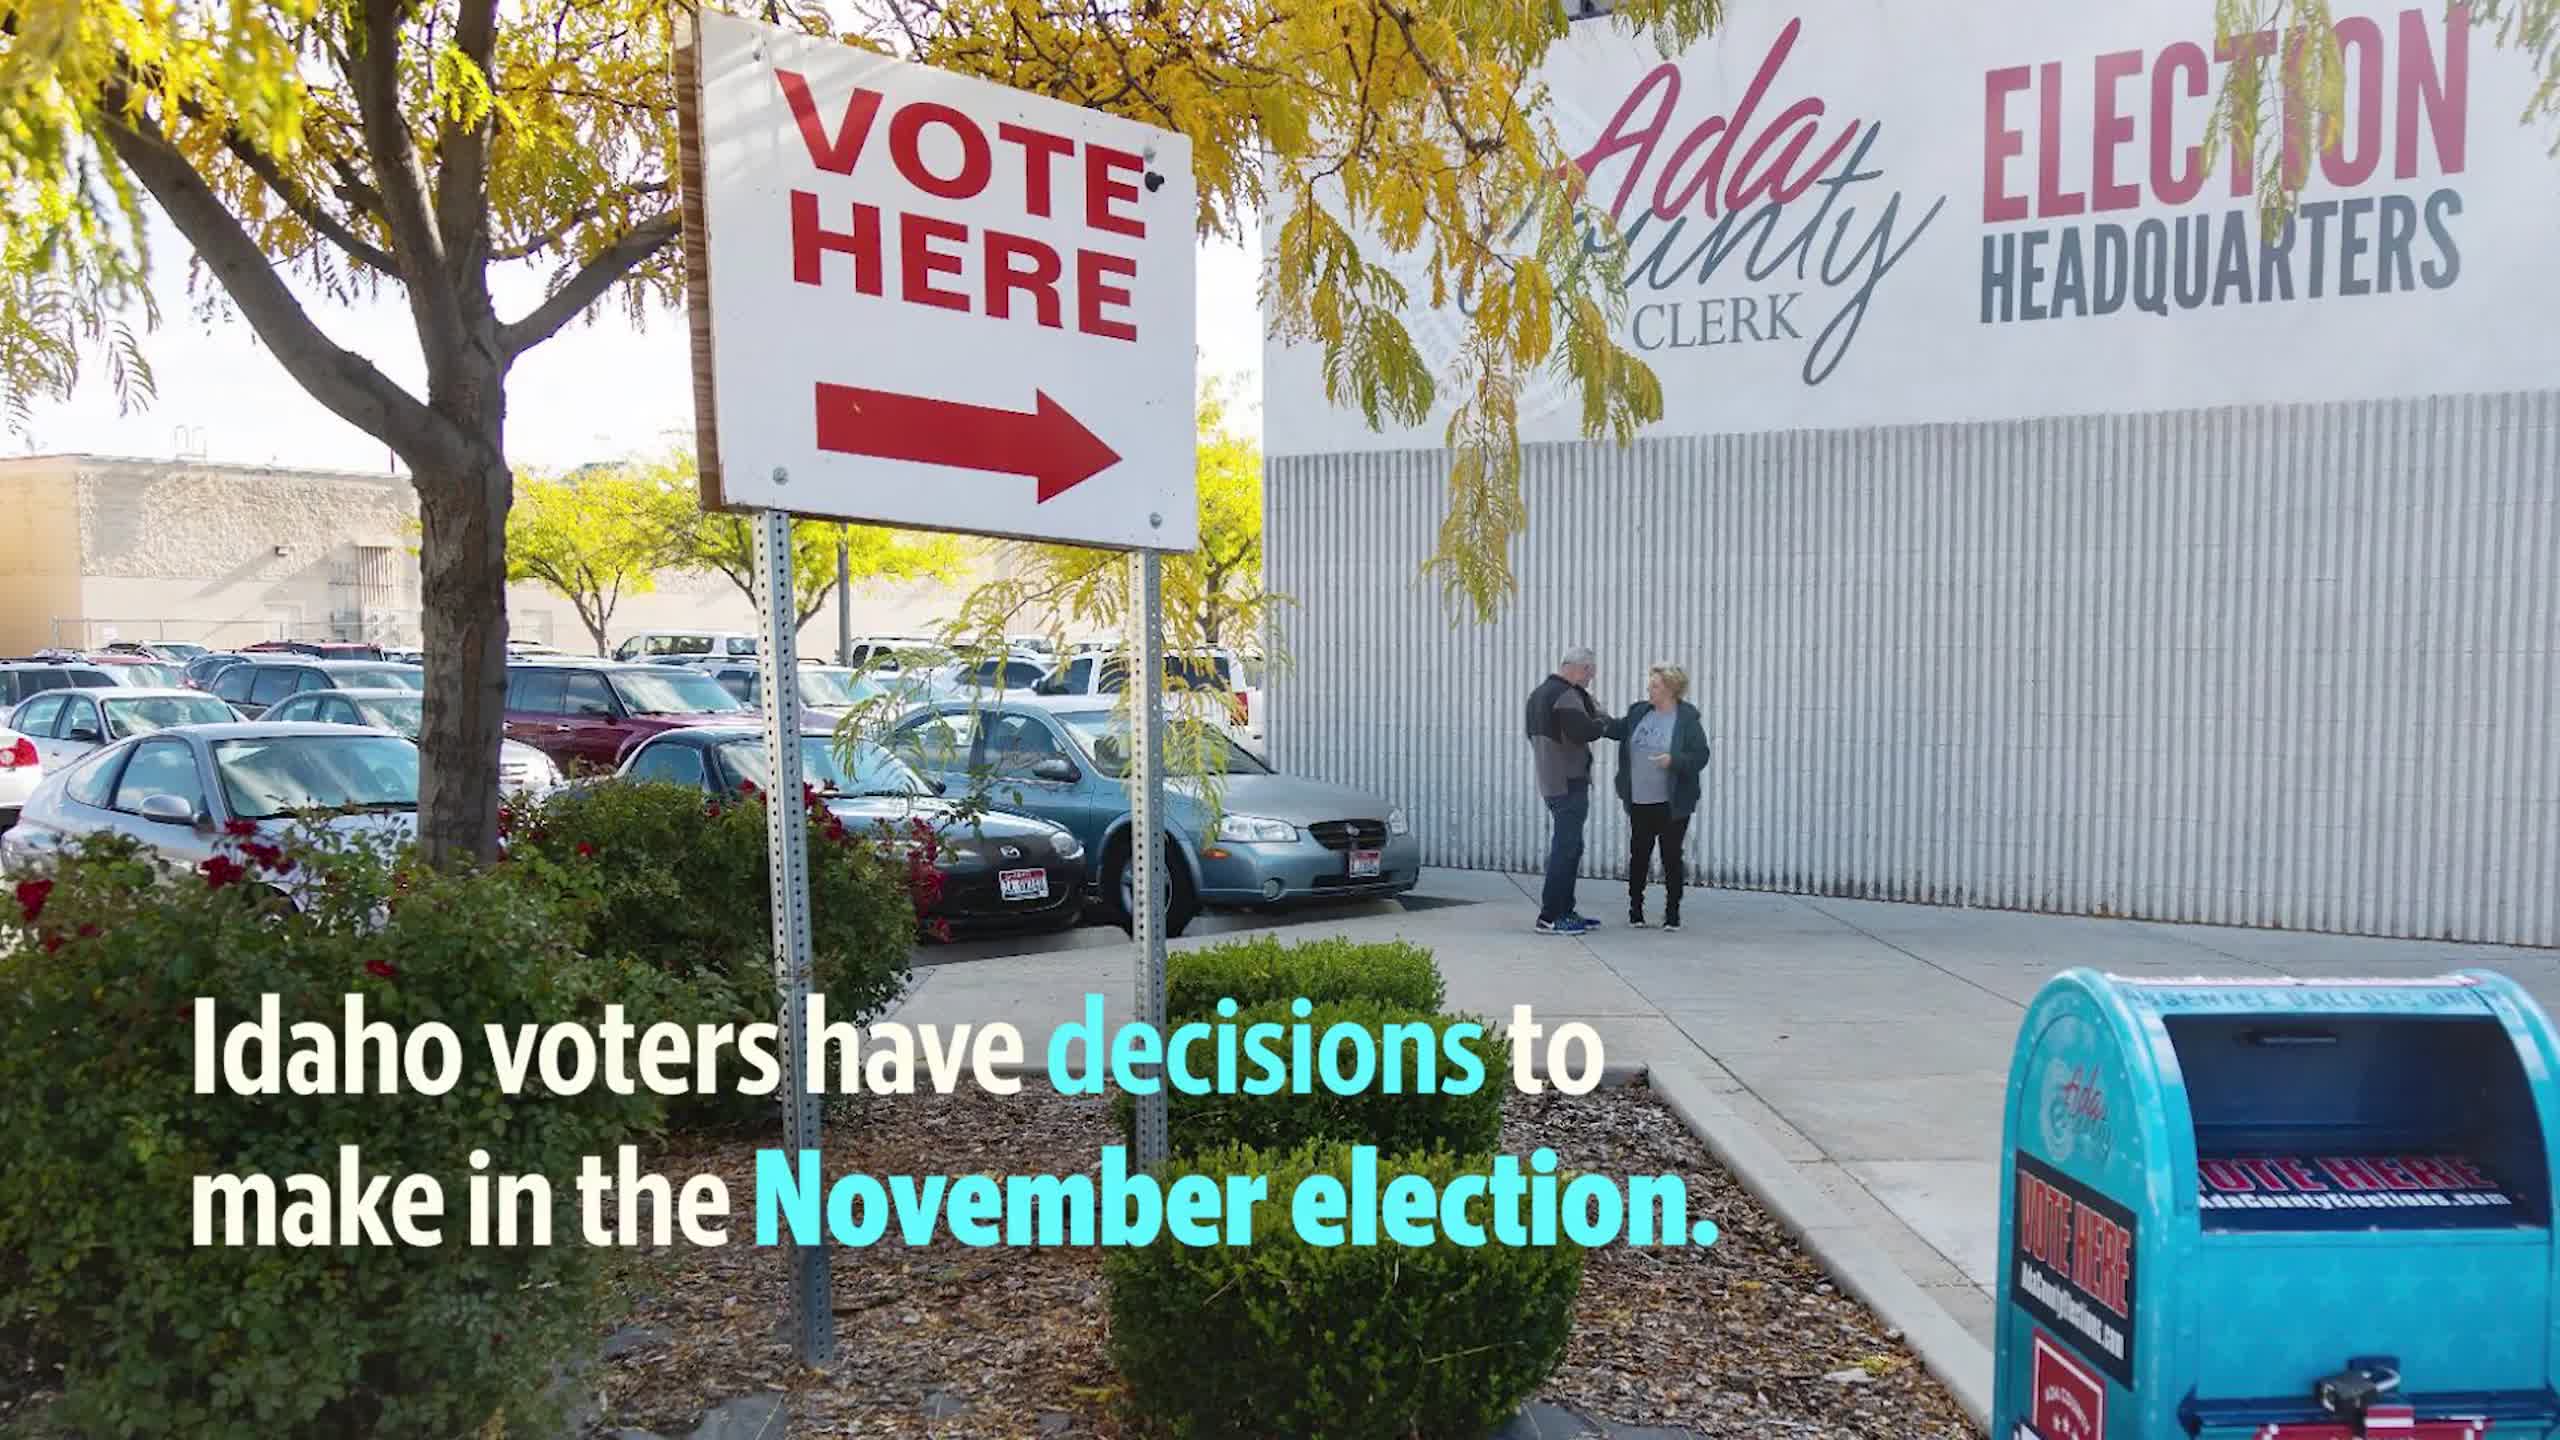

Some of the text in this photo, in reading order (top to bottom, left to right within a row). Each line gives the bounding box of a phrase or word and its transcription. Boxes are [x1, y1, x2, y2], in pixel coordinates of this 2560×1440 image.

[775, 68, 1145, 239] VOTE
[1557, 17, 1861, 221] Ada
[1982, 4, 2470, 223] ELECTION
[790, 189, 1138, 343] HERE
[1457, 120, 1946, 386] unty
[1632, 291, 1803, 351] CLERK
[1980, 188, 2463, 324] HEADQUARTERS
[2019, 1169, 2131, 1320] VOTE HERE
[2198, 1156, 2499, 1191] OTE HERE
